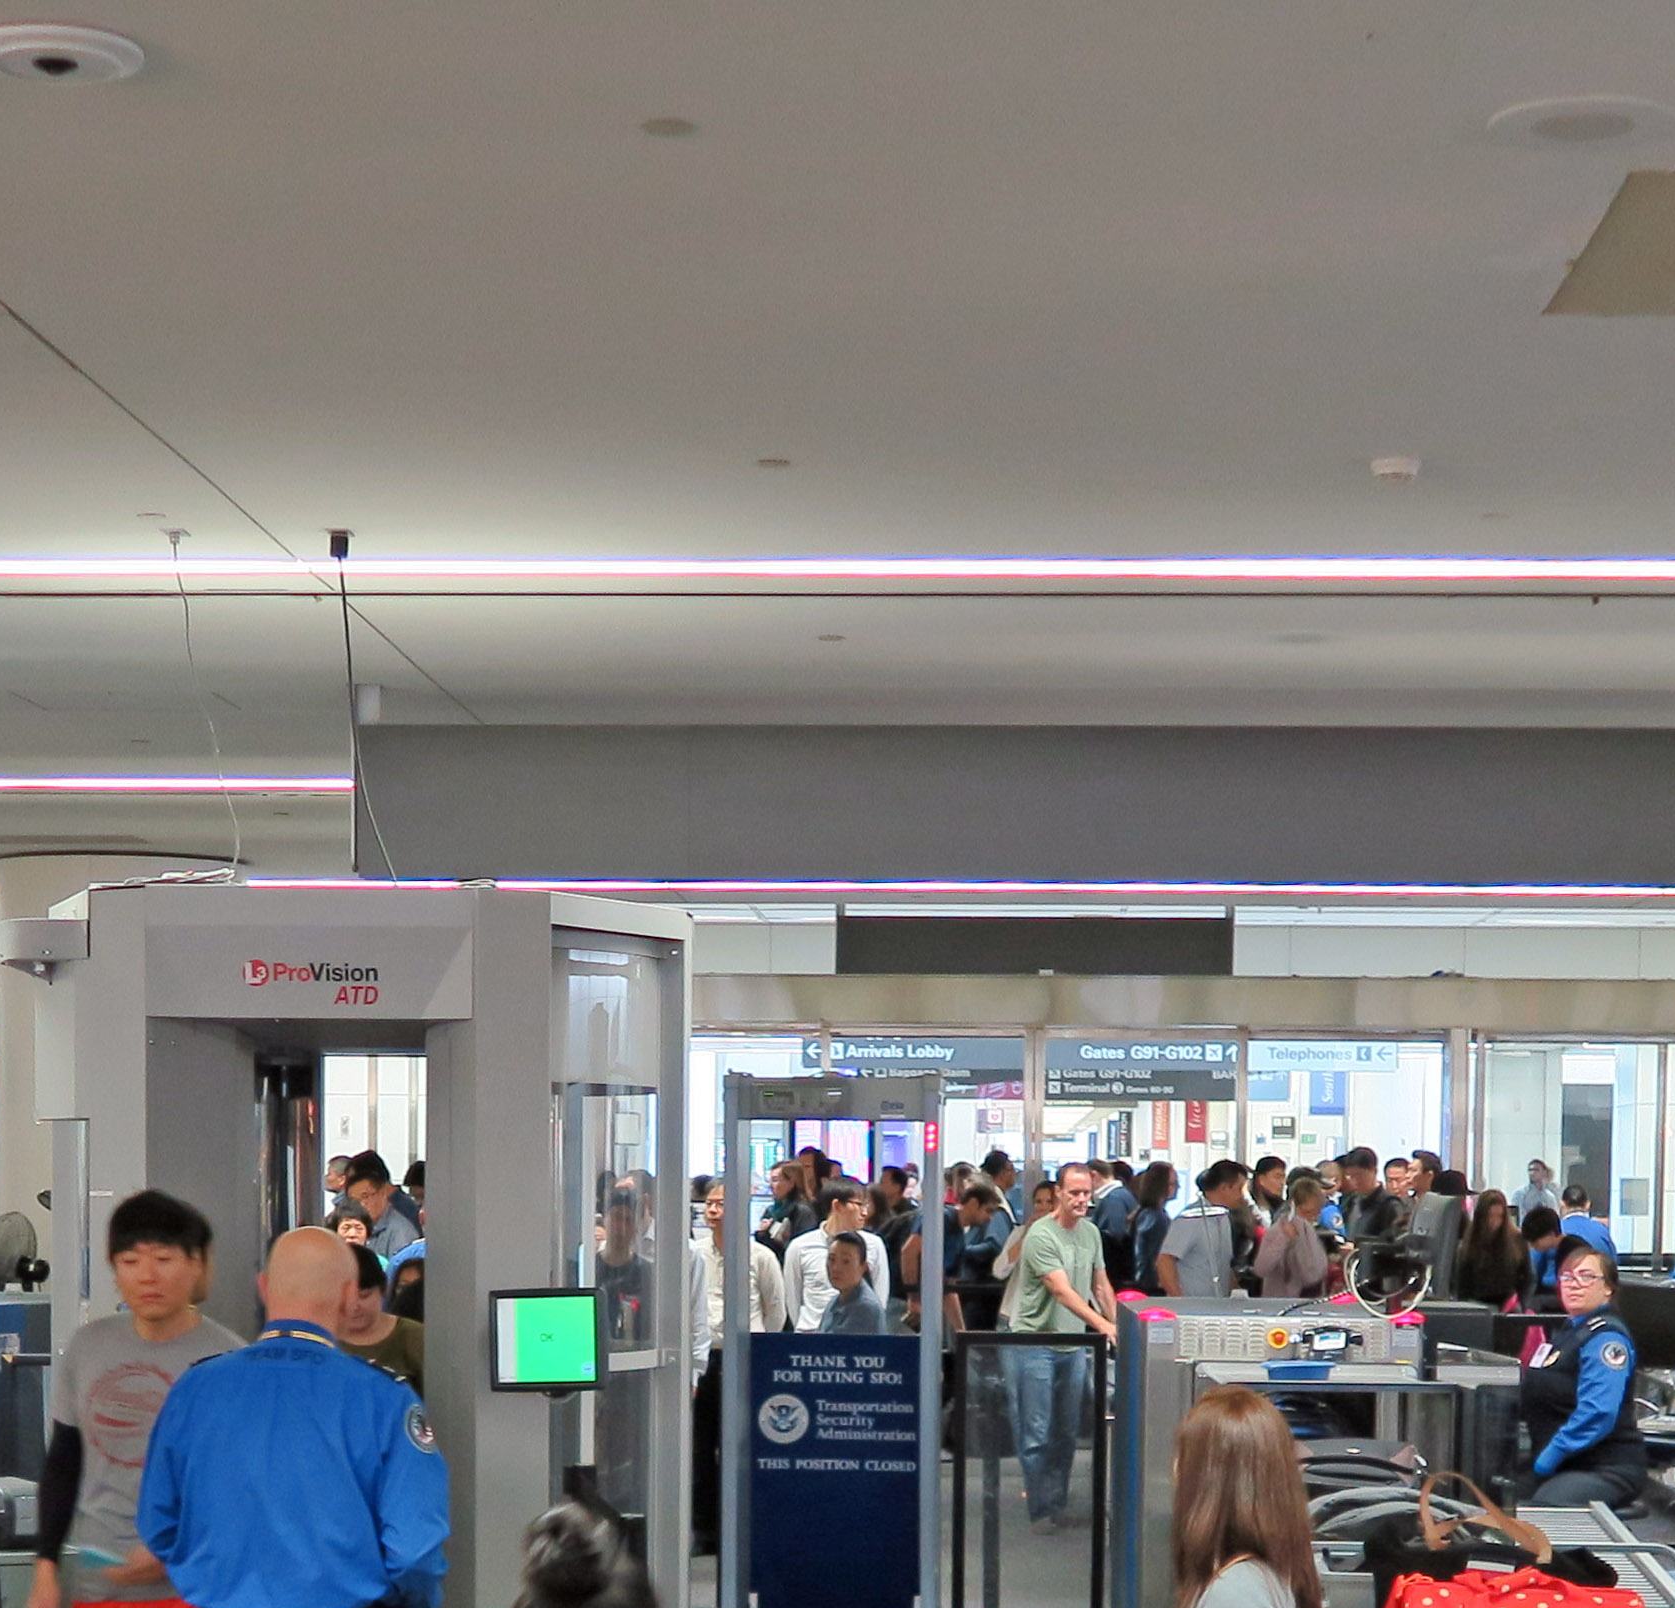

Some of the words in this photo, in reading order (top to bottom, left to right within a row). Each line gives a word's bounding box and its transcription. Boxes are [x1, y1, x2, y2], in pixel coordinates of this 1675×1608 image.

[273, 963, 378, 982] ProVision
[334, 986, 380, 1005] ATD
[845, 1043, 904, 1059] Arrivals
[907, 1042, 954, 1061] Lobby
[1080, 1044, 1126, 1060] Gates
[1130, 1044, 1203, 1060] G91-G102
[1268, 1047, 1352, 1062] Telephones
[1062, 1069, 1096, 1079] Gates
[1063, 1082, 1110, 1094] Terminal
[539, 1333, 554, 1342] OK
[789, 1355, 846, 1368] THANK
[853, 1356, 885, 1368] YOU
[773, 1370, 803, 1382] FOR
[809, 1371, 863, 1383] FLYING
[870, 1372, 902, 1385] SFO!
[815, 1400, 914, 1415] Transportation
[815, 1414, 874, 1429] Security
[816, 1428, 916, 1441] Administration
[757, 1458, 789, 1470] THIS
[795, 1459, 859, 1470] POSITION
[865, 1460, 916, 1472] CLOSED
